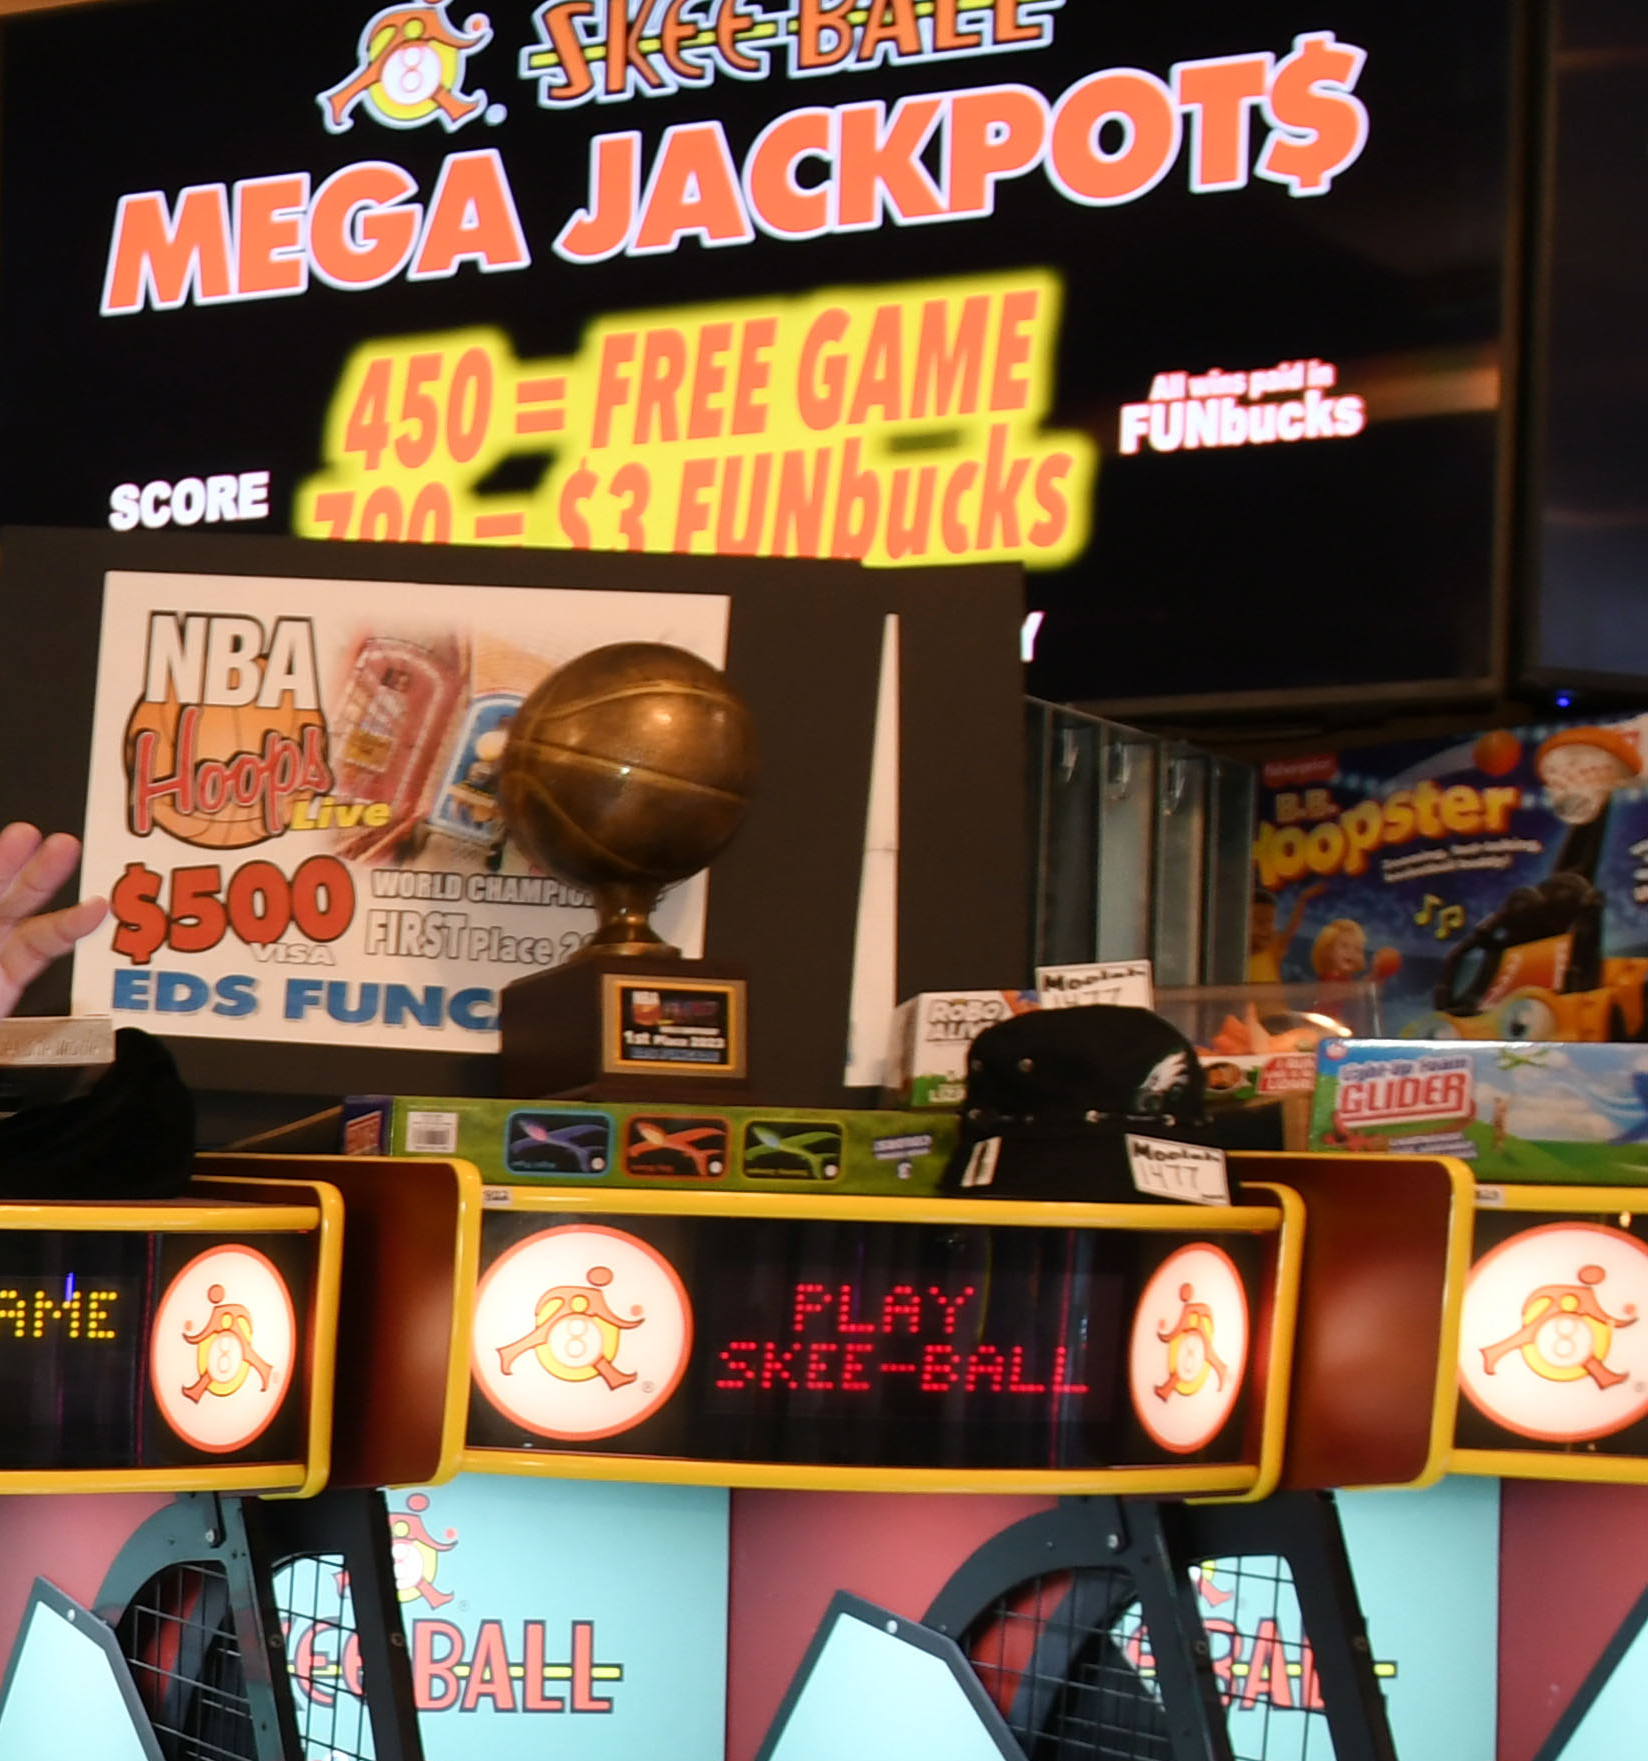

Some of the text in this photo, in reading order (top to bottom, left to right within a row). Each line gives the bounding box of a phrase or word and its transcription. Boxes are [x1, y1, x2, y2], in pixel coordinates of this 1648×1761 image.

[102, 33, 1369, 315] MEGA JACKPOT$
[343, 346, 493, 471] 450
[590, 317, 779, 449] FREE
[796, 288, 1042, 432] GAME
[1118, 388, 1367, 455] FUNbucks
[108, 471, 271, 533] SCORE
[673, 422, 1073, 559] FUNbucks
[146, 609, 321, 711] NBA
[126, 704, 333, 837] Hoops
[290, 795, 391, 832] Live
[111, 855, 356, 965] $500
[372, 868, 463, 901] WORLD
[249, 941, 337, 967] VISA
[366, 909, 468, 959] FIRST
[469, 926, 553, 965] Place
[111, 969, 502, 1030] EDS FUNC
[1340, 1073, 1469, 1115] GLIDER
[794, 1283, 977, 1336] PLAY
[715, 1341, 1090, 1395] SKEE-BALL
